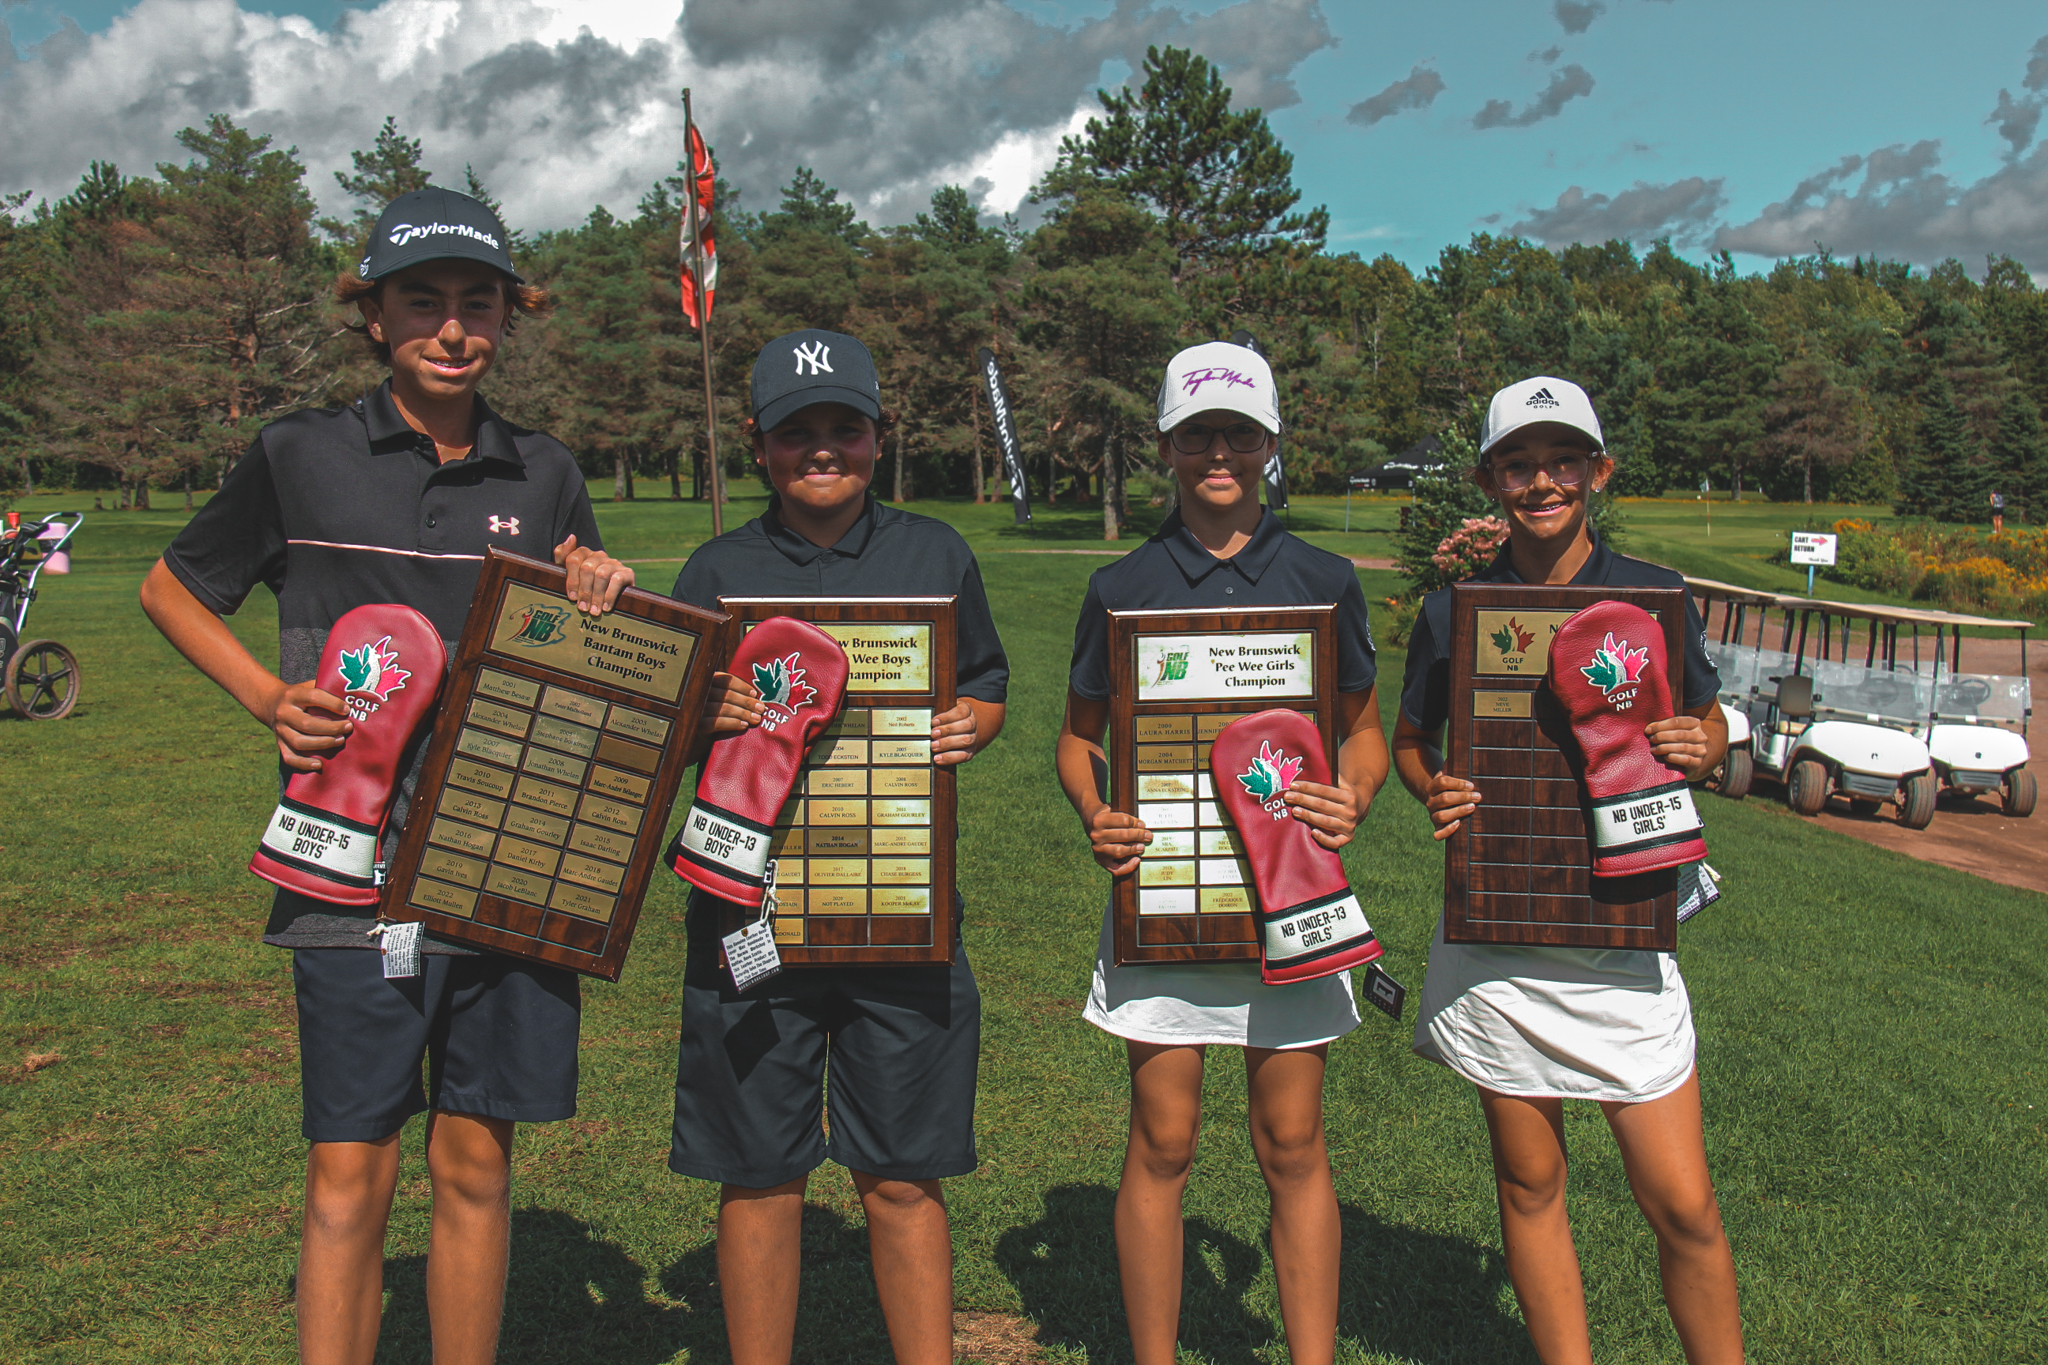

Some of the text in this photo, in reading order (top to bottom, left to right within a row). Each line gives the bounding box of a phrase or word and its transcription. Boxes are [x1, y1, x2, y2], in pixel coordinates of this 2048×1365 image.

[389, 222, 499, 250] TaylorMade
[793, 340, 834, 375] NY
[1526, 398, 1560, 407] adidas
[534, 610, 560, 623] GOLF
[520, 620, 557, 642] NB
[580, 618, 678, 656] New Brunswick
[852, 637, 917, 648] Brunswick
[584, 637, 666, 670] Bantam Boys
[1166, 652, 1190, 661] GOLF
[1209, 644, 1301, 657] New Brunswick
[852, 654, 911, 667] Wee Boys
[1215, 660, 1295, 672] Pee Wee Girls
[588, 656, 653, 682] Champion
[1160, 661, 1189, 681] NB
[482, 682, 511, 695] Matthew
[1225, 676, 1286, 689] Champion
[1607, 687, 1638, 704] GOLF
[345, 695, 380, 713] GOLF
[1615, 700, 1633, 712] NB
[349, 708, 367, 722] NB
[471, 711, 525, 731] Alexander Whelan
[492, 710, 508, 719] 2004
[610, 718, 663, 738] Alexander Whelan
[761, 718, 777, 732] NB
[466, 742, 481, 752] Kyle
[483, 738, 499, 747] 2007
[548, 757, 565, 766] 2008
[473, 769, 490, 778] 2010
[527, 760, 580, 779] Jonathan Whelan
[455, 772, 475, 783] Travis
[613, 775, 628, 784] 2009
[538, 788, 554, 797] 2011
[464, 799, 481, 808] 2013
[521, 792, 568, 809] Brandon Pierce
[1264, 798, 1286, 812] GOL
[452, 804, 488, 819] Calvin Ross
[603, 806, 620, 815] 2012
[1273, 808, 1289, 821] NB
[1612, 796, 1682, 824] NB UNDER-15
[529, 817, 546, 826] 2014
[591, 811, 627, 825] Calvin Ross
[1633, 815, 1667, 835] GIRLS'
[278, 814, 351, 850] NB UNDER-15
[455, 829, 472, 838] 2016
[510, 820, 561, 840] Graham Gourley
[693, 815, 757, 852] NB UNDER-13
[438, 833, 483, 852] Nathan Hogan
[594, 835, 610, 843] 2015
[292, 837, 328, 859] BOYS'
[520, 847, 537, 856] 2017
[580, 839, 620, 856] Isaac Darling
[703, 837, 734, 859] BOYS'
[446, 859, 463, 868] 2019
[507, 852, 545, 868] Daniel Kirby
[436, 865, 467, 878] Gavin Ives
[584, 864, 601, 874] 2018
[511, 876, 528, 886] 2020
[597, 876, 618, 886] Gaudet
[437, 889, 453, 898] 2022
[496, 881, 537, 896] Jacob LeBlanc
[422, 894, 463, 909] Elliott Mullen
[575, 894, 590, 902] 2021
[561, 899, 600, 914] Tyler Graham
[1281, 906, 1347, 938] NB UNDER-13
[1302, 925, 1333, 948] GIRLS'
